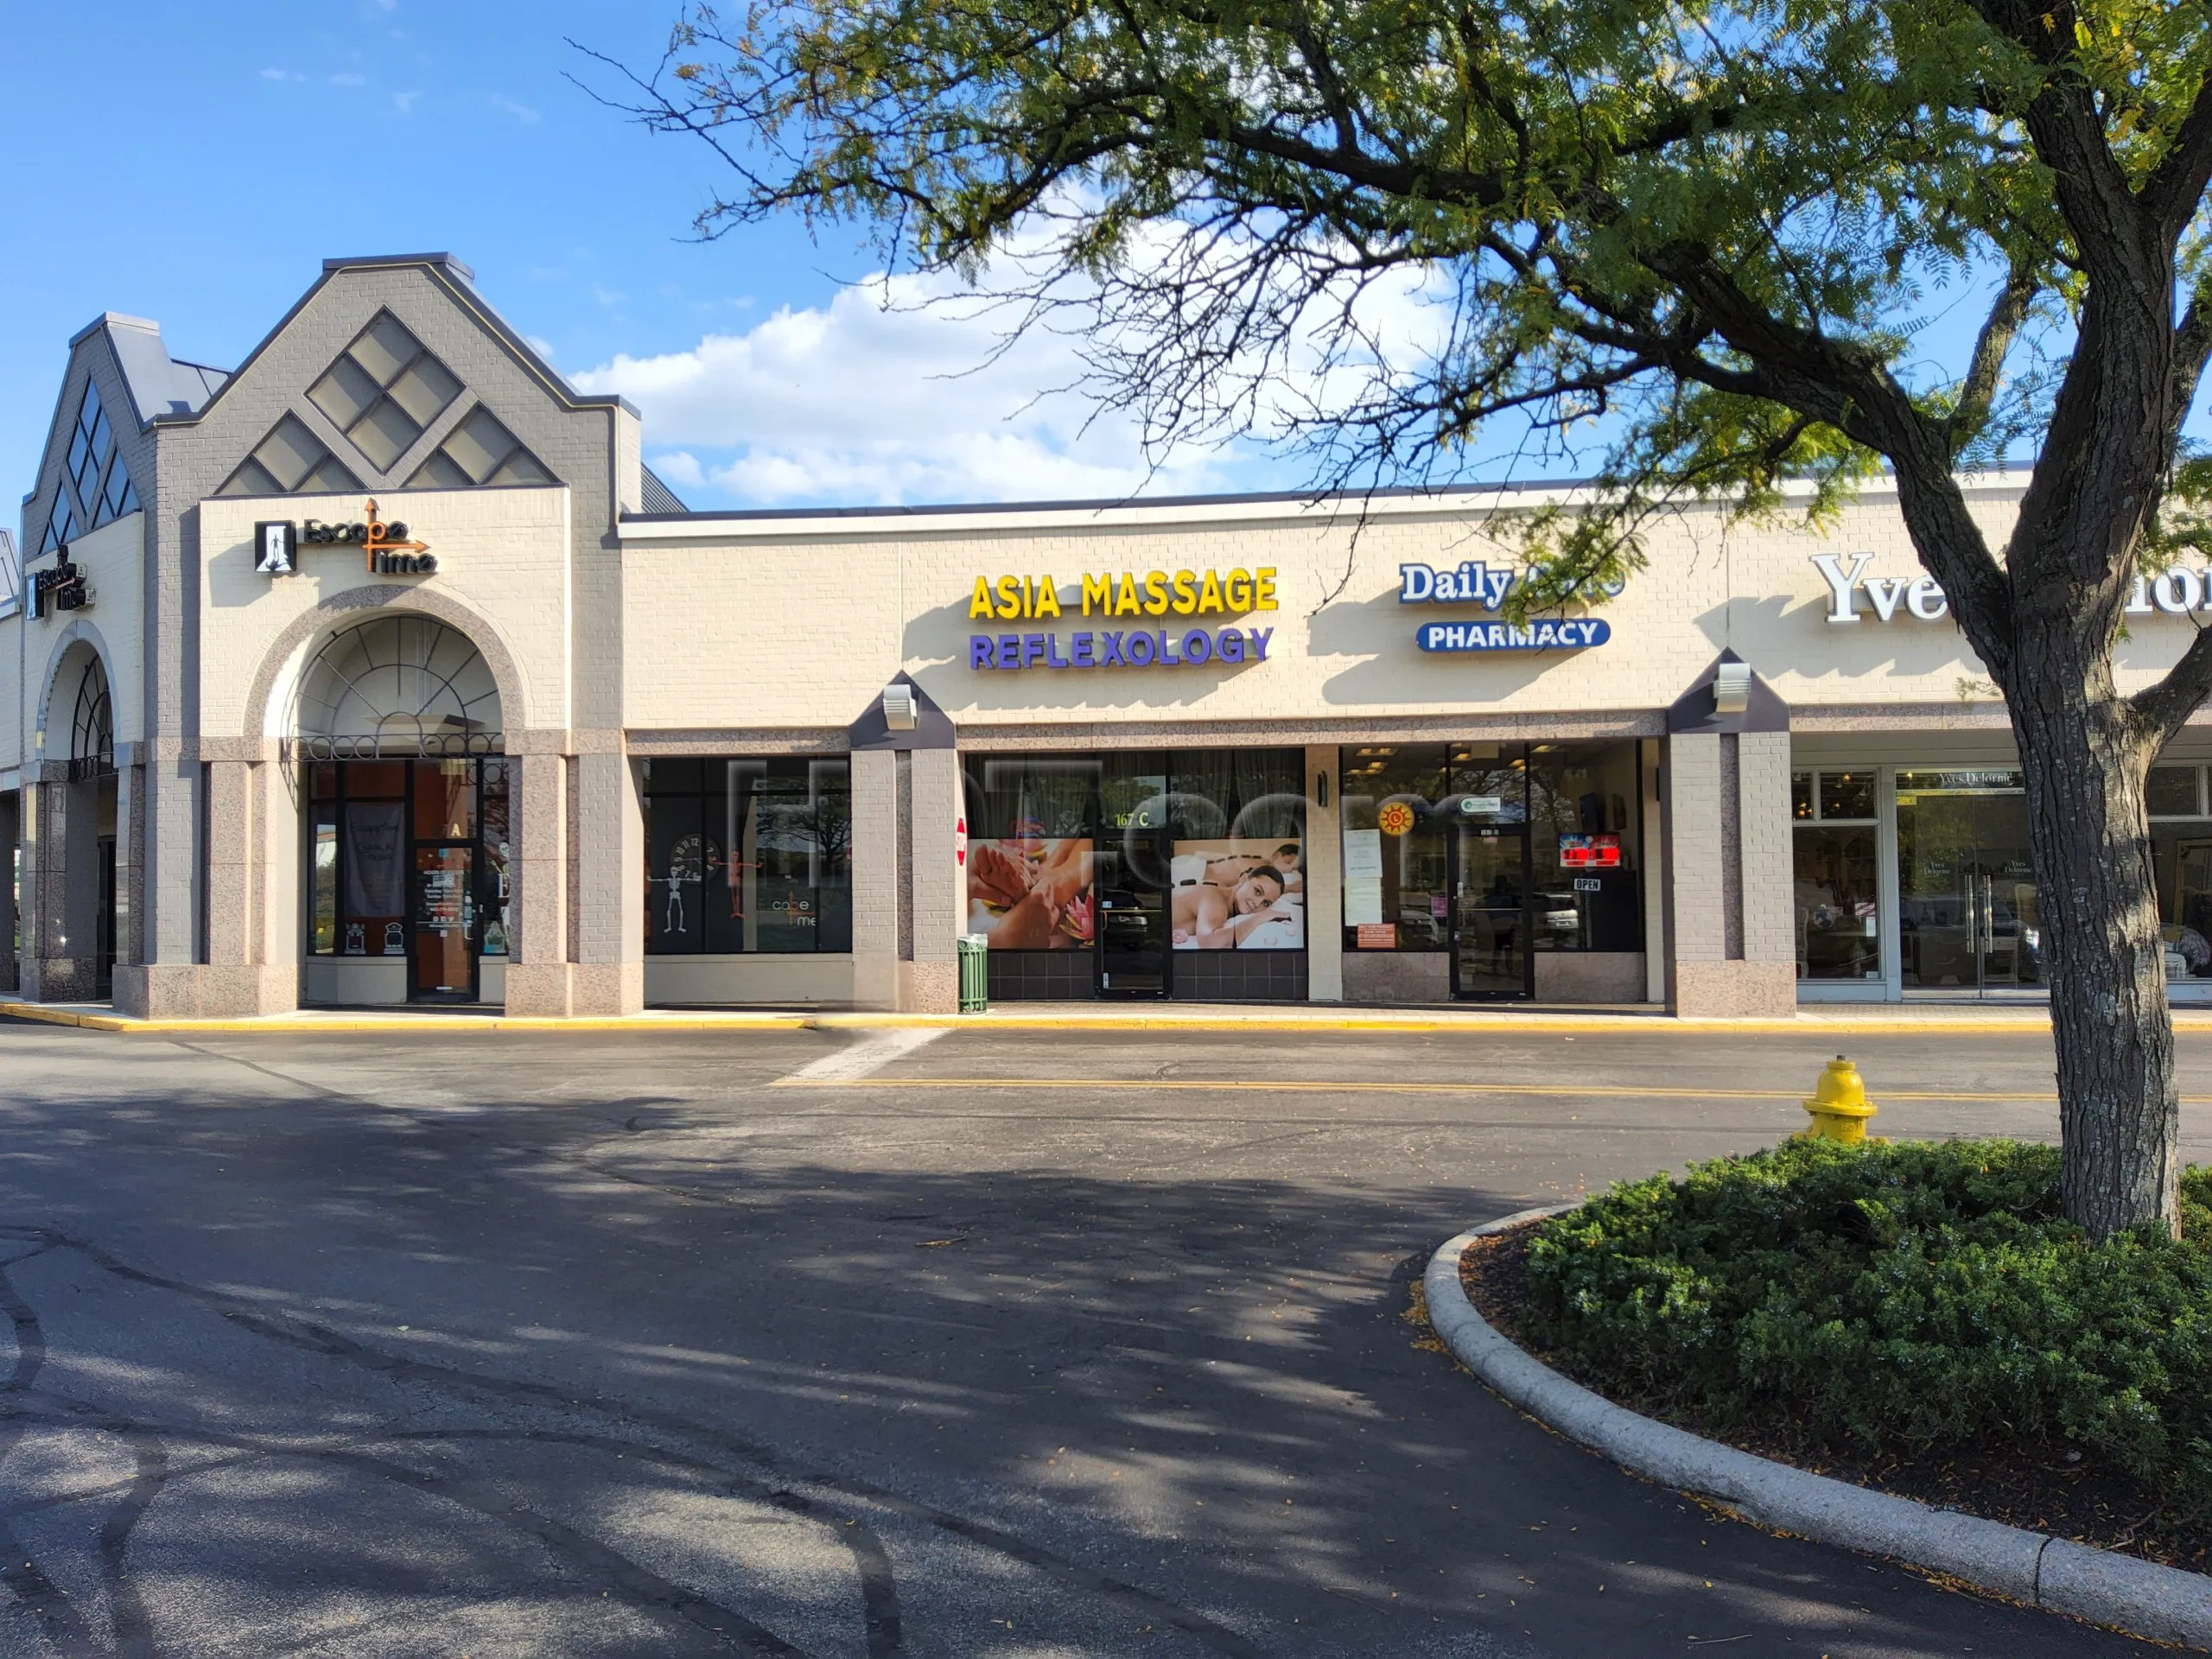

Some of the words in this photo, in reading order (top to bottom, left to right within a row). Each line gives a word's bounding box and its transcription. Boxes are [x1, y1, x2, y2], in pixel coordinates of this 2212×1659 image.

[304, 519, 410, 543] Escape
[969, 574, 1062, 620] ASIA
[1082, 567, 1279, 617] MASSAGE
[1401, 563, 1512, 608] Daily
[1808, 551, 1948, 622] Yve
[1428, 621, 1598, 648] PHARMACY
[969, 626, 1275, 671] REFLEXOLOGY
[451, 823, 461, 836] A
[1116, 813, 1135, 826] 167
[1139, 811, 1148, 827] C
[1576, 879, 1599, 890] OPEN
